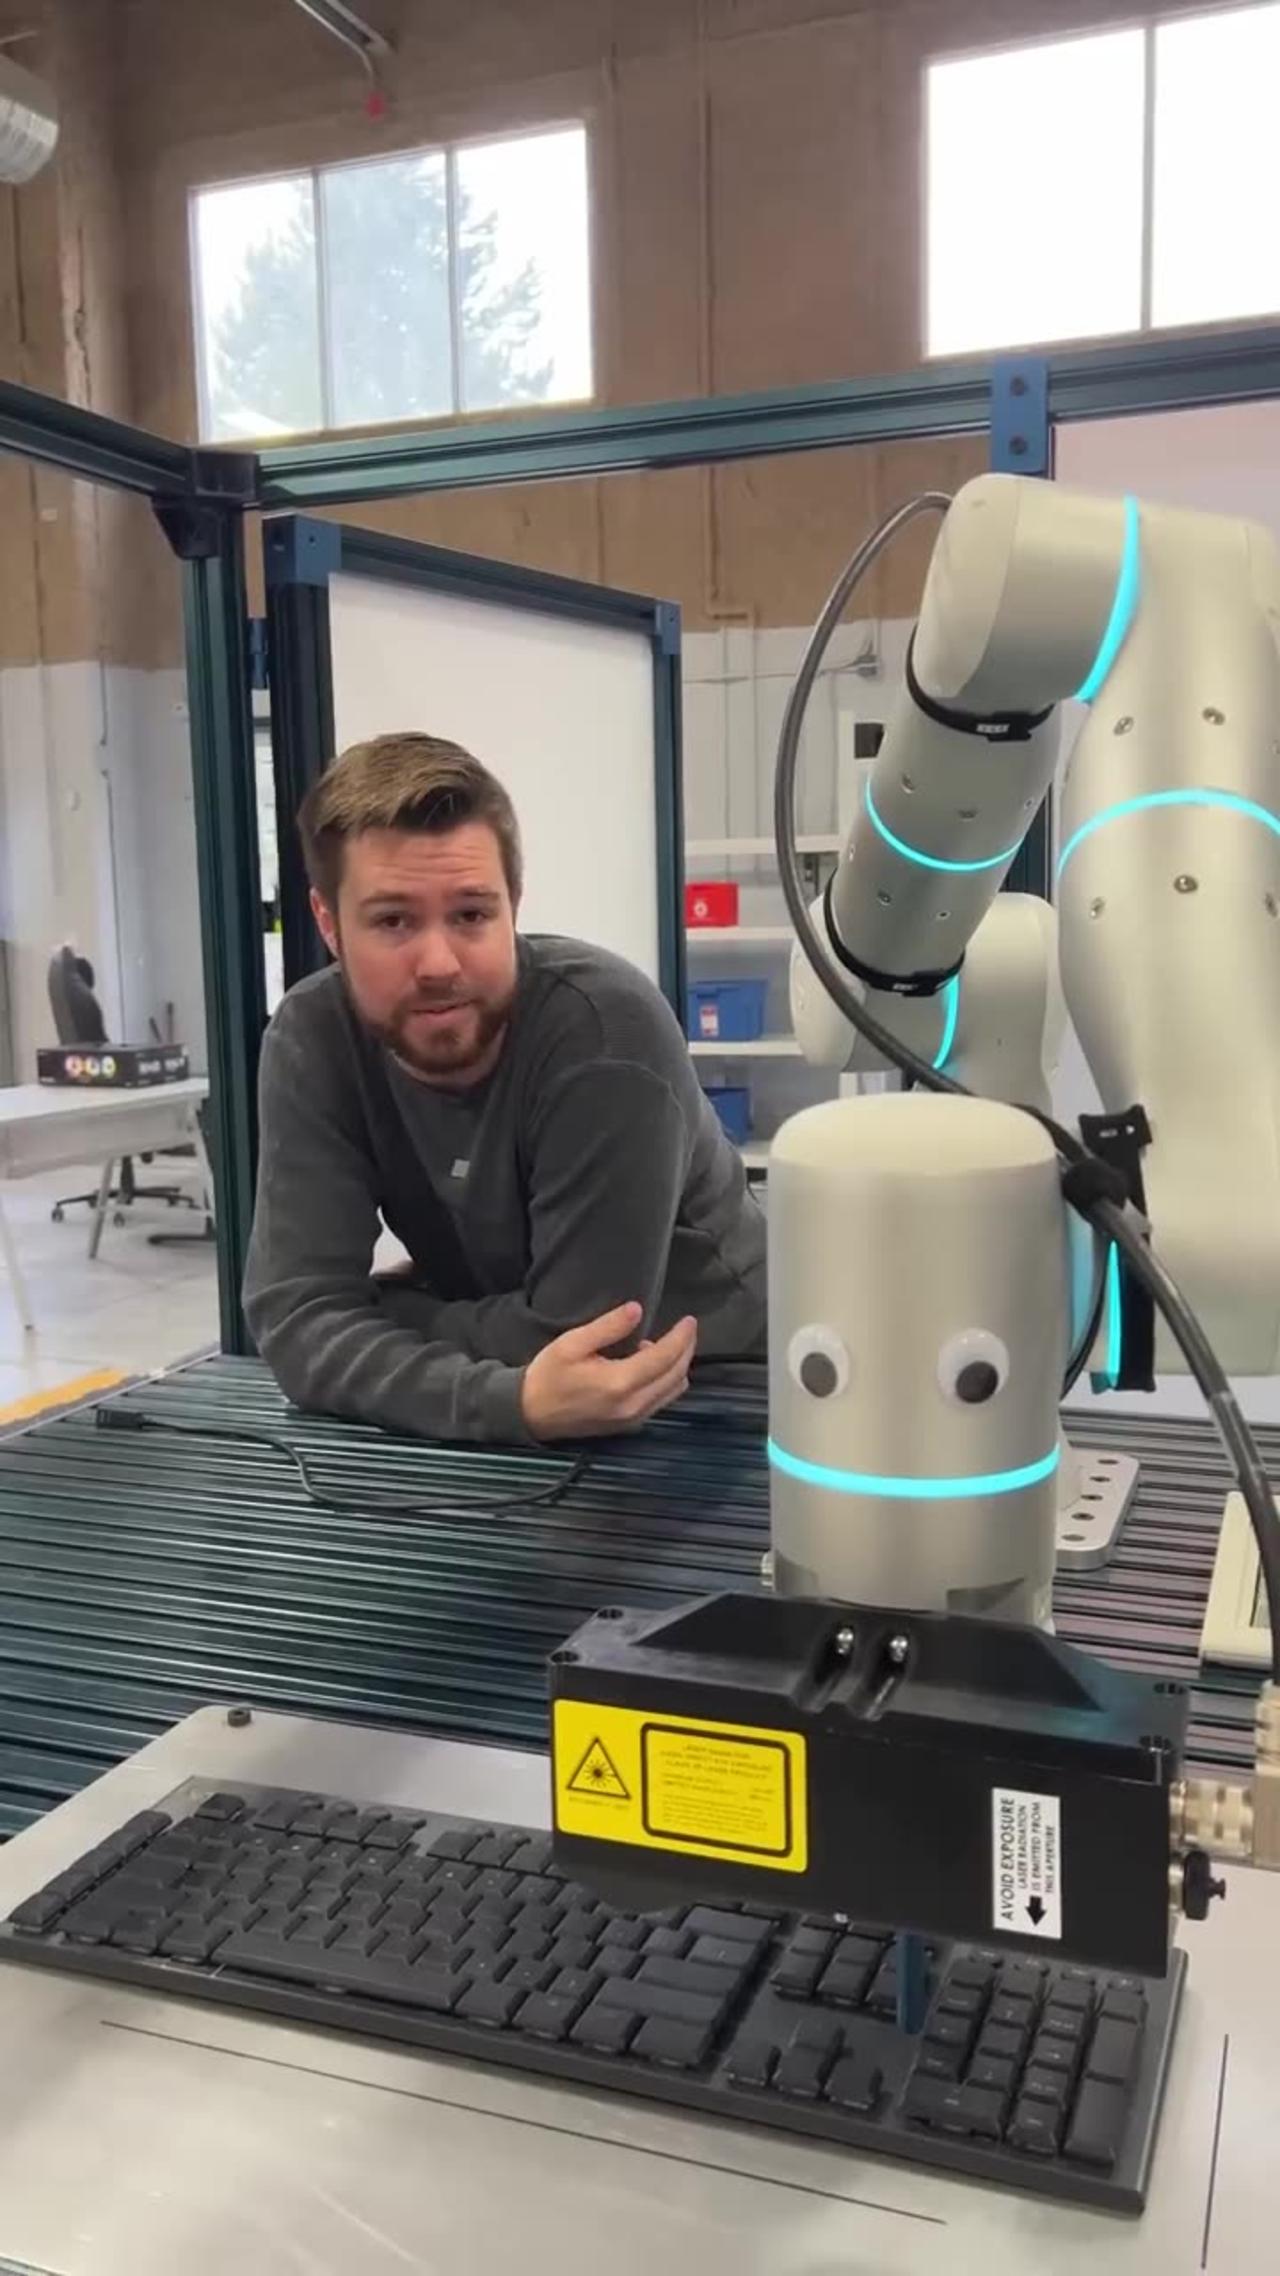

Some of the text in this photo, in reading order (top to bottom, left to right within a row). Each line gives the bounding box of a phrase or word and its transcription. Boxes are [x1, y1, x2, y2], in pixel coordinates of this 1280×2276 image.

[1000, 1797, 1015, 1921] AVOID EXPOSURE
[1017, 1805, 1028, 1889] LASER RADIATION
[1031, 1802, 1041, 1892] IS EMITTED FROM
[1044, 1825, 1055, 1894] THIS APERTURE
